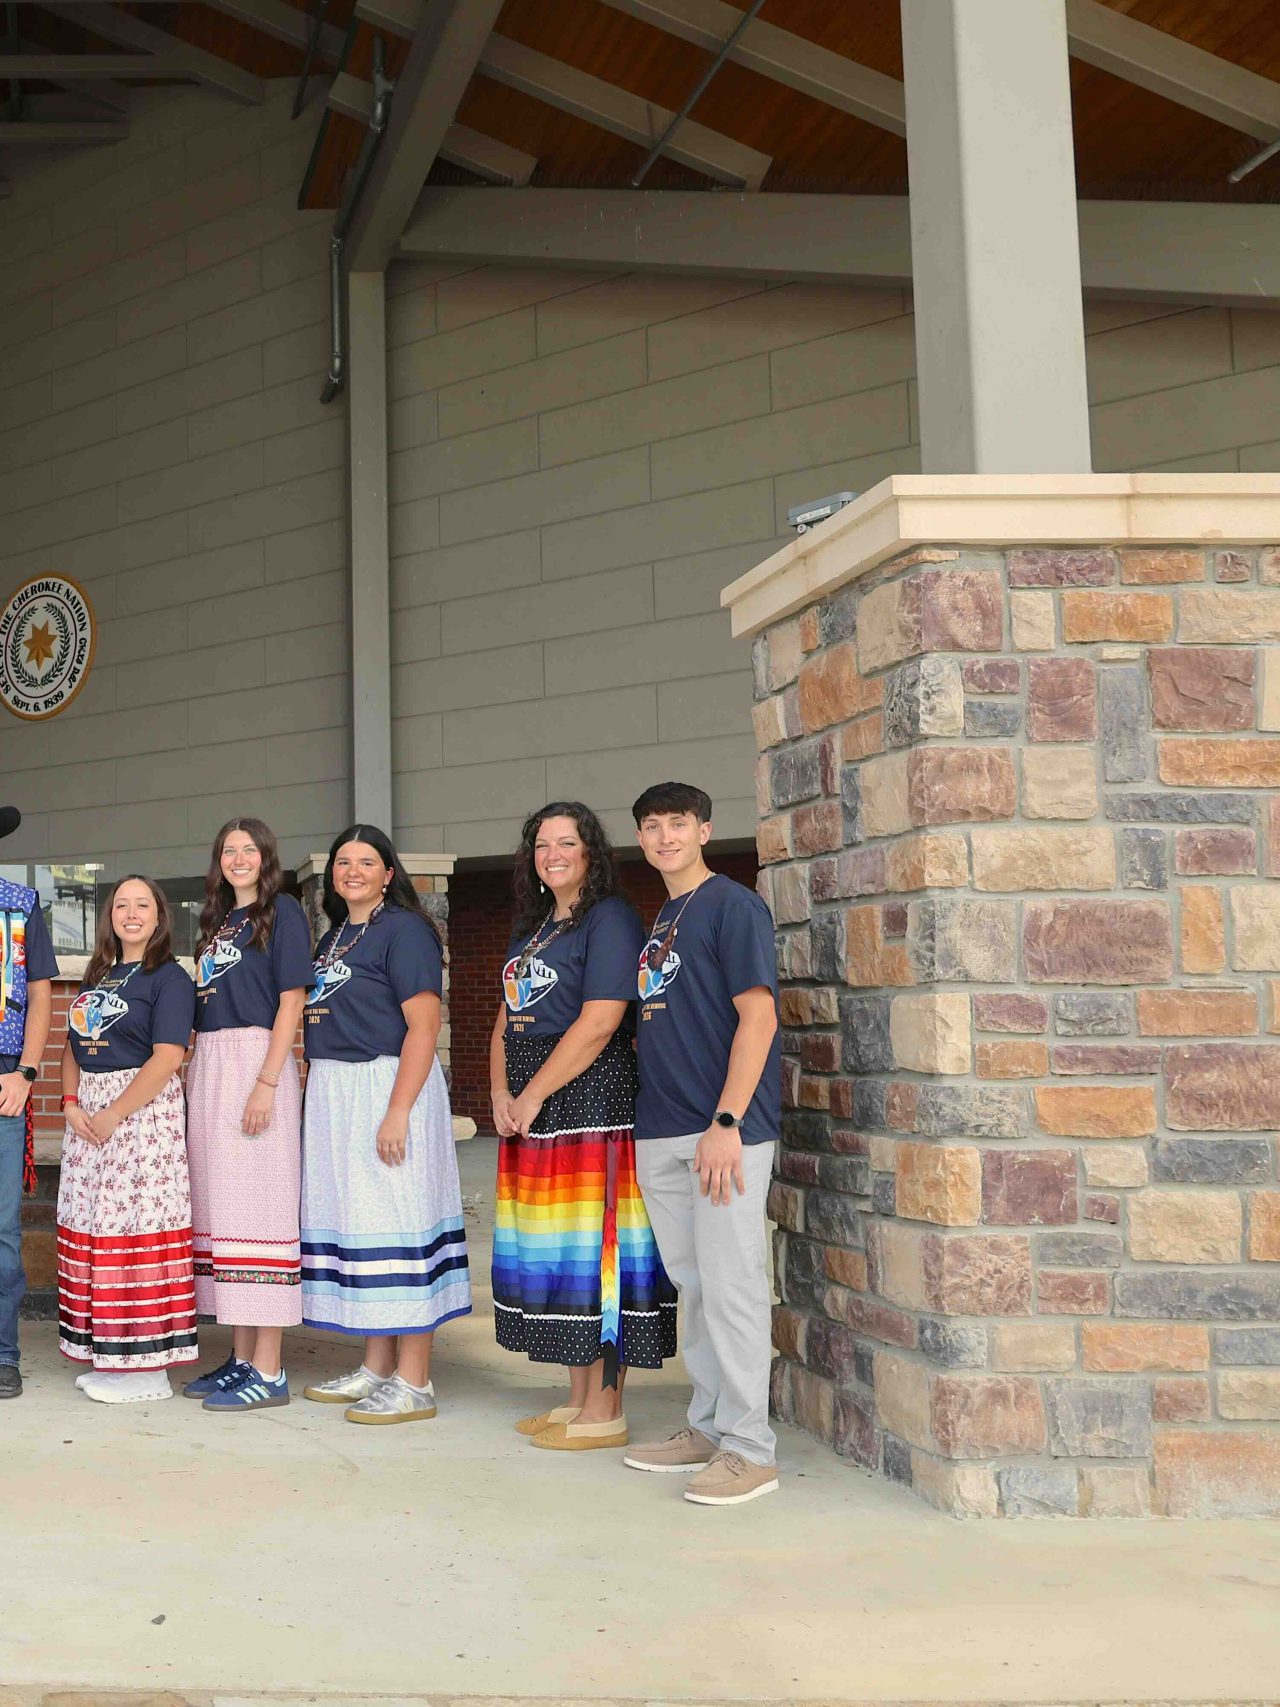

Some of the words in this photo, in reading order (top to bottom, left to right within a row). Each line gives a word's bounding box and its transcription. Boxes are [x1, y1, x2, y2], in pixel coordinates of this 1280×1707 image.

[12, 581, 64, 610] CHEROKEE
[64, 588, 88, 632] NATION
[43, 691, 65, 709] 1839
